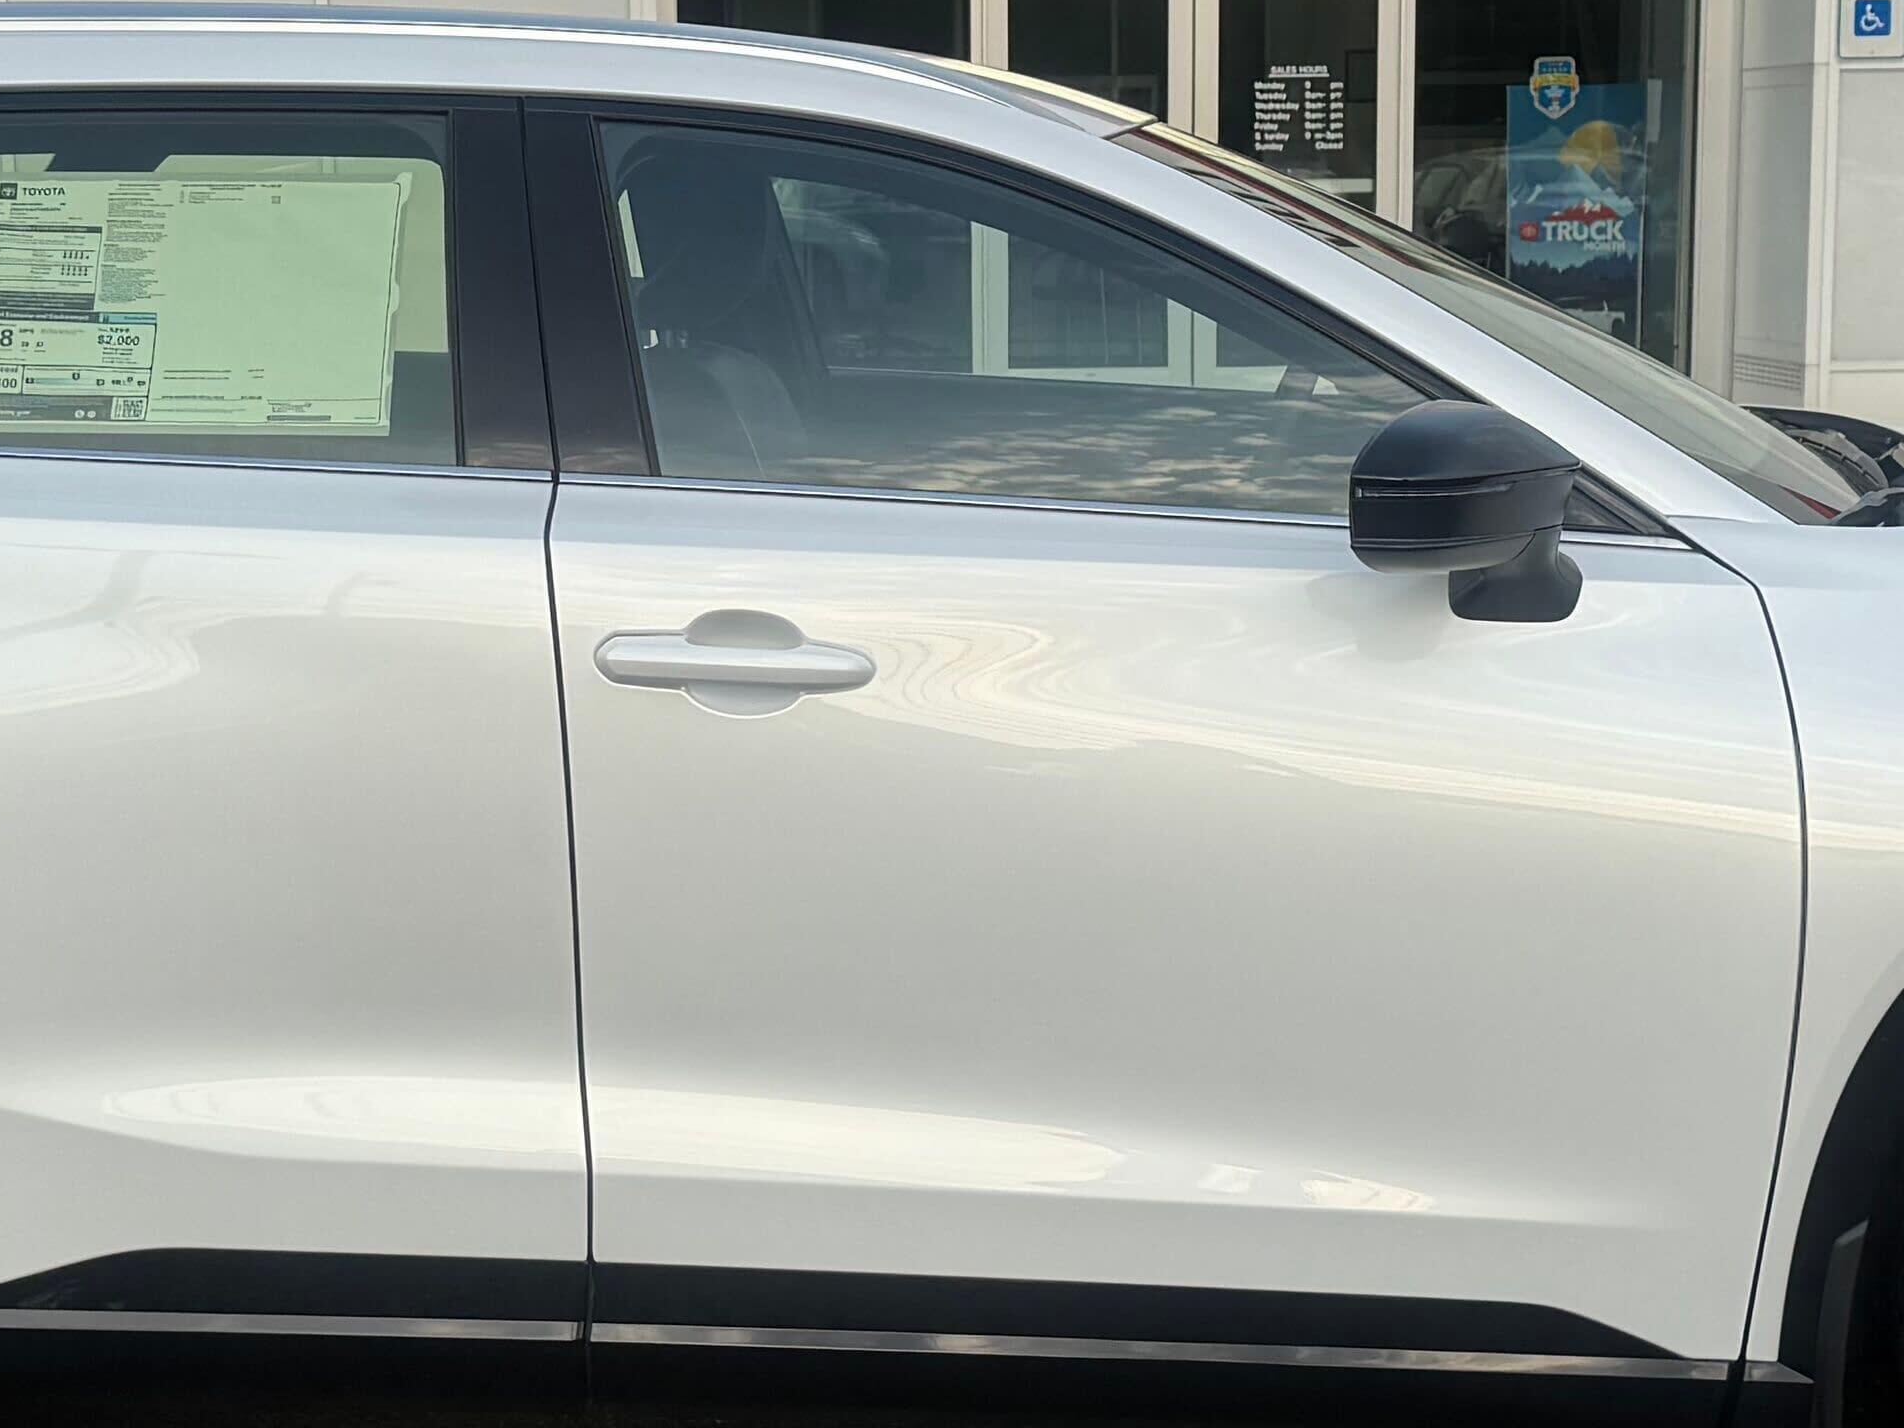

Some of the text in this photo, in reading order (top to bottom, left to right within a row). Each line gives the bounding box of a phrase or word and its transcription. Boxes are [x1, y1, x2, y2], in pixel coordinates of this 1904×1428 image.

[1270, 65, 1328, 74] SALES HOURS
[1255, 92, 1287, 100] Tuesday
[1255, 112, 1290, 121] Thursday
[1255, 132, 1289, 141] Sturday
[22, 186, 66, 197] TOYOTA
[1542, 219, 1624, 241] TRUCK
